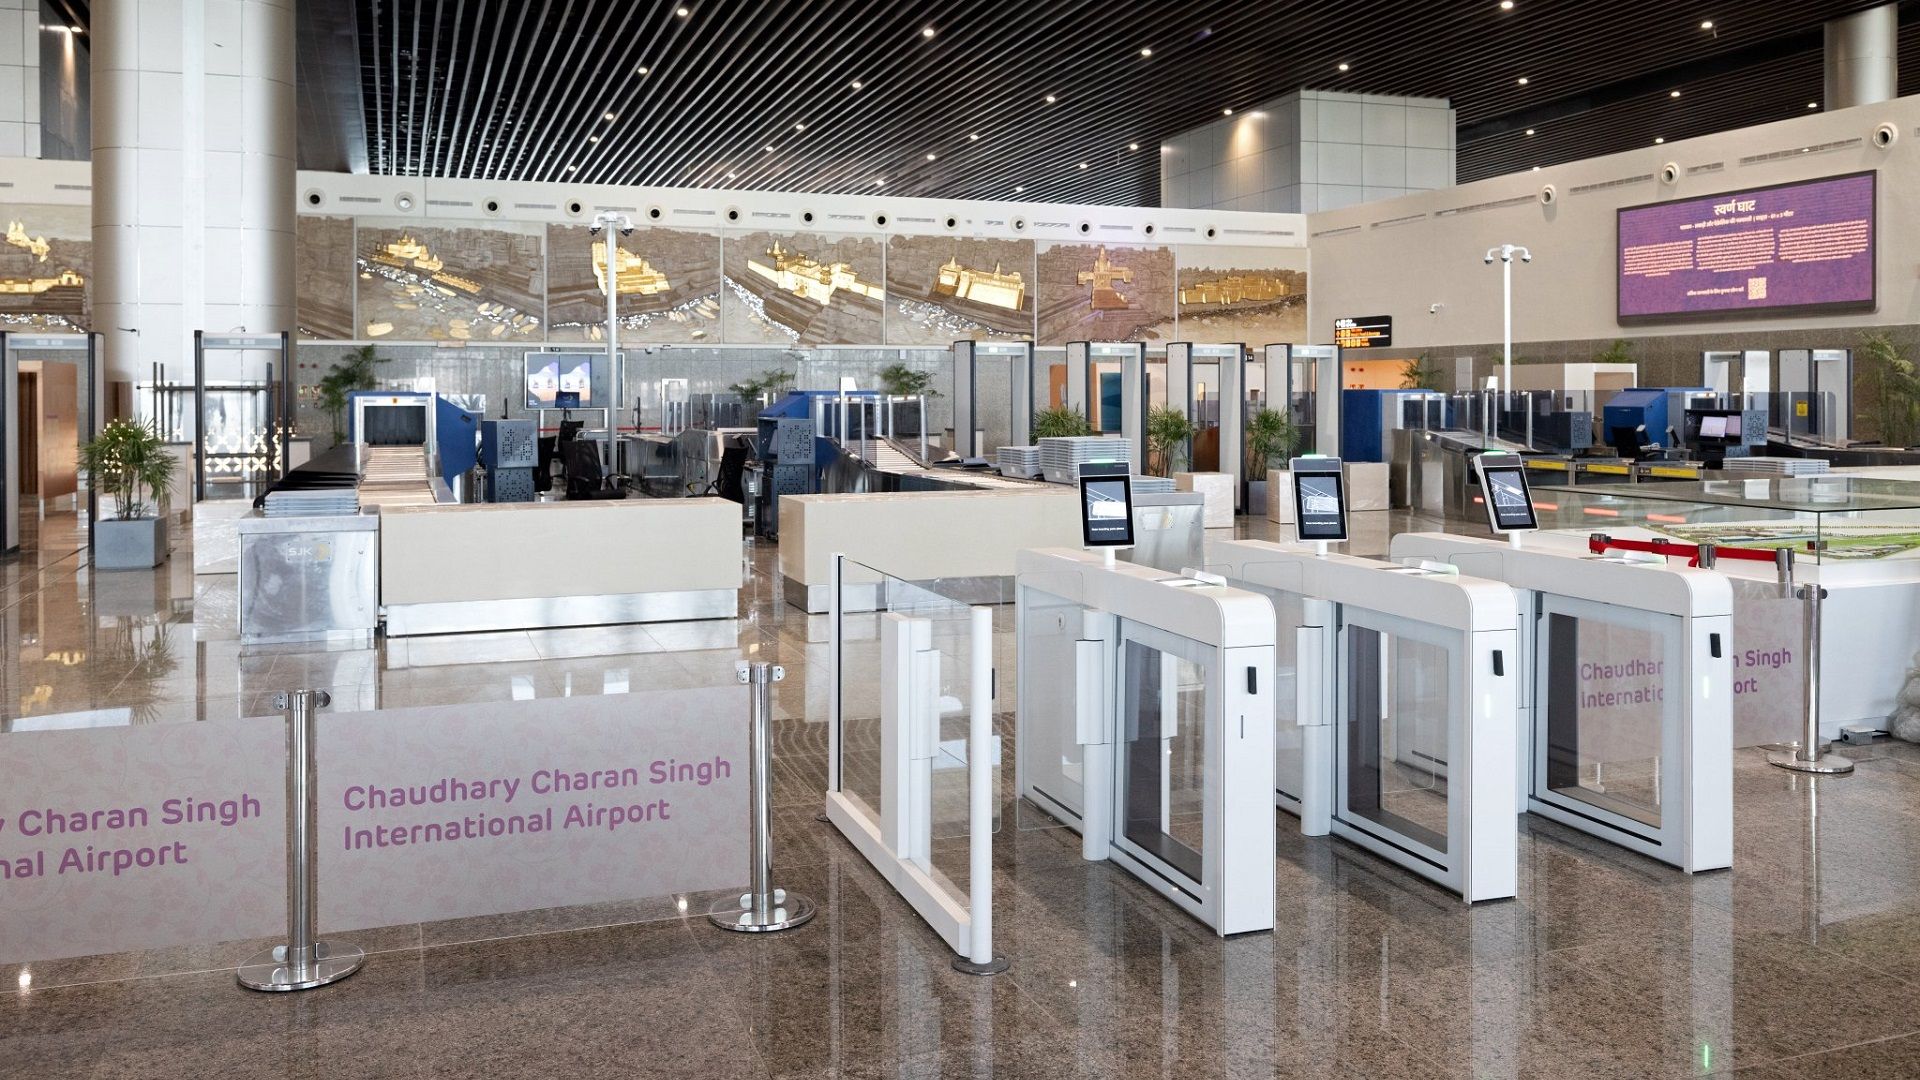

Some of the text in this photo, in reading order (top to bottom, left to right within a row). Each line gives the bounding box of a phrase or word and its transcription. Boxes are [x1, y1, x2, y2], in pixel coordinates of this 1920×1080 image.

[1737, 200, 1756, 212] घाट
[288, 547, 313, 556] SJK
[1580, 658, 1664, 681] Chaudhar
[1745, 647, 1792, 669] Singh
[343, 756, 731, 812] Chaudhary Charan Singh
[18, 808, 148, 837] Charan
[161, 793, 261, 827] Singh
[343, 799, 671, 851] International Airport
[58, 841, 189, 877] Airport
